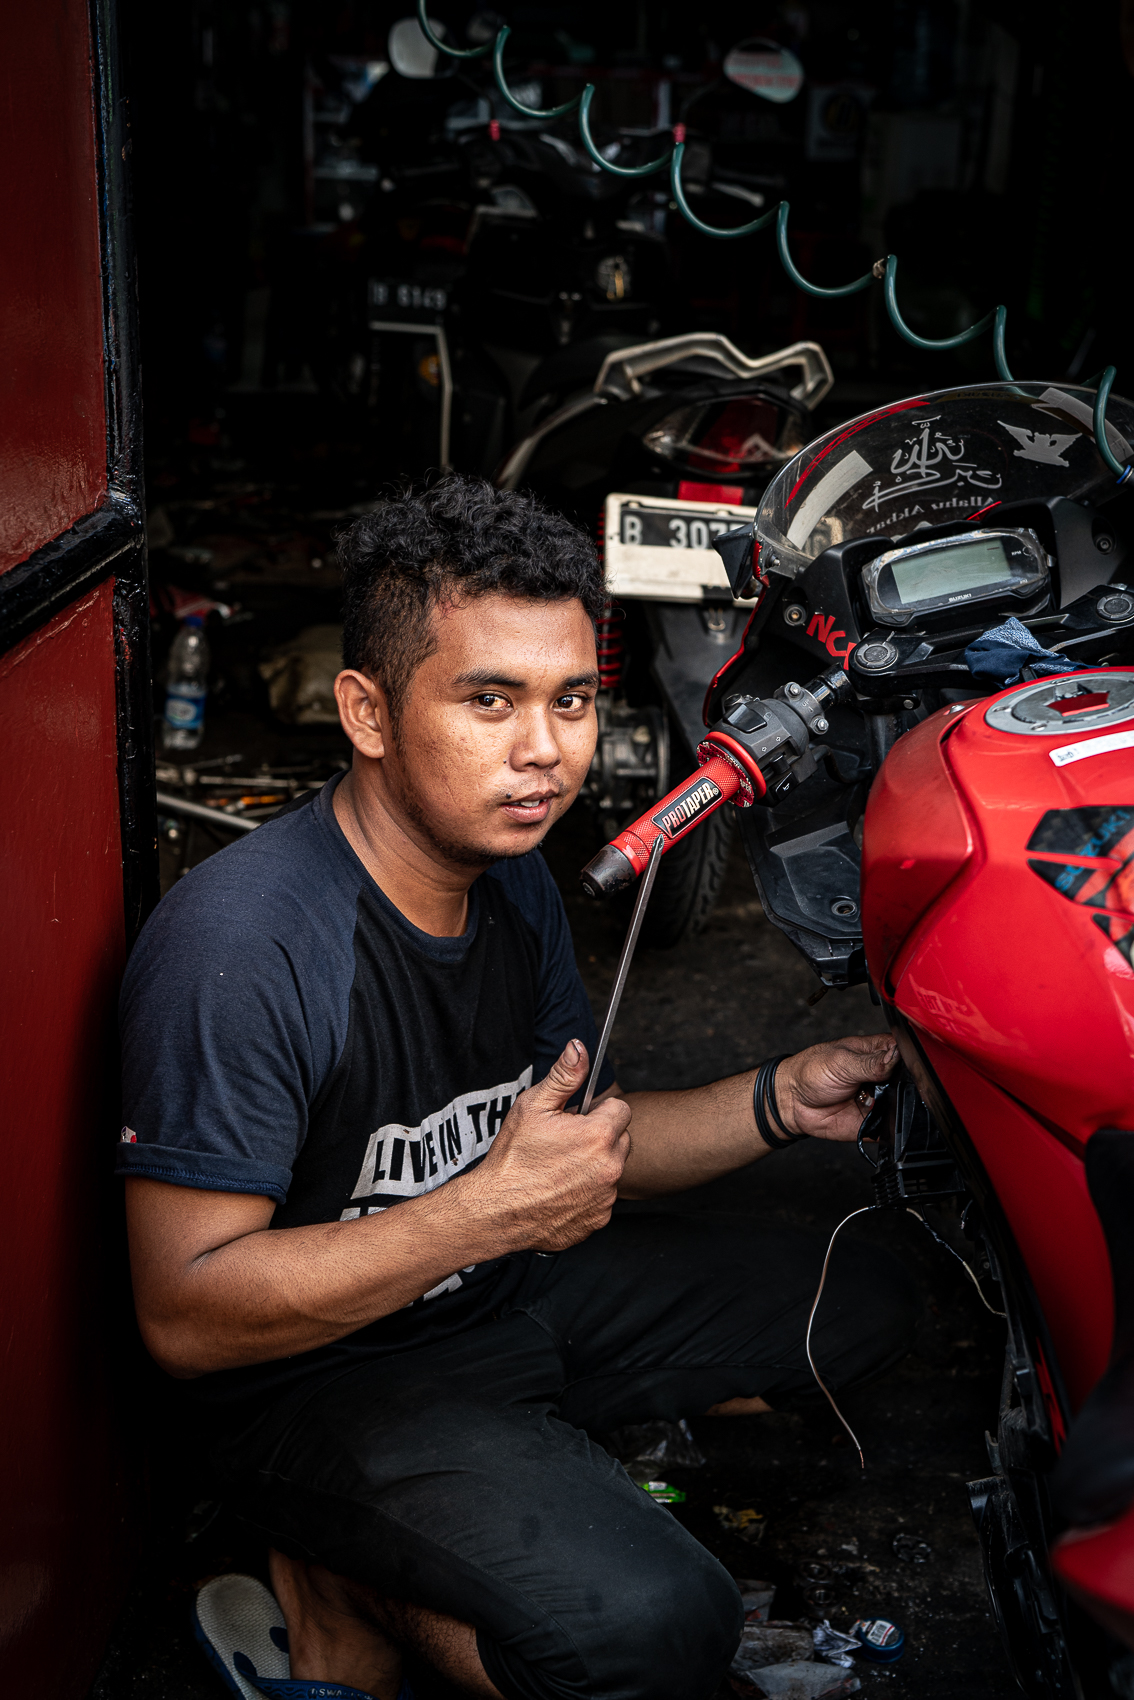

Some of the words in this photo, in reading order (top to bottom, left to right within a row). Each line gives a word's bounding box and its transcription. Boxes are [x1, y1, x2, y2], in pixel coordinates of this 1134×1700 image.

[622, 514, 643, 545] B
[948, 593, 972, 602] SUZUKI
[1054, 809, 1130, 891] SUZUKI
[372, 1131, 438, 1184] LIVE
[438, 1112, 463, 1166] IN
[466, 1086, 527, 1145] TH
